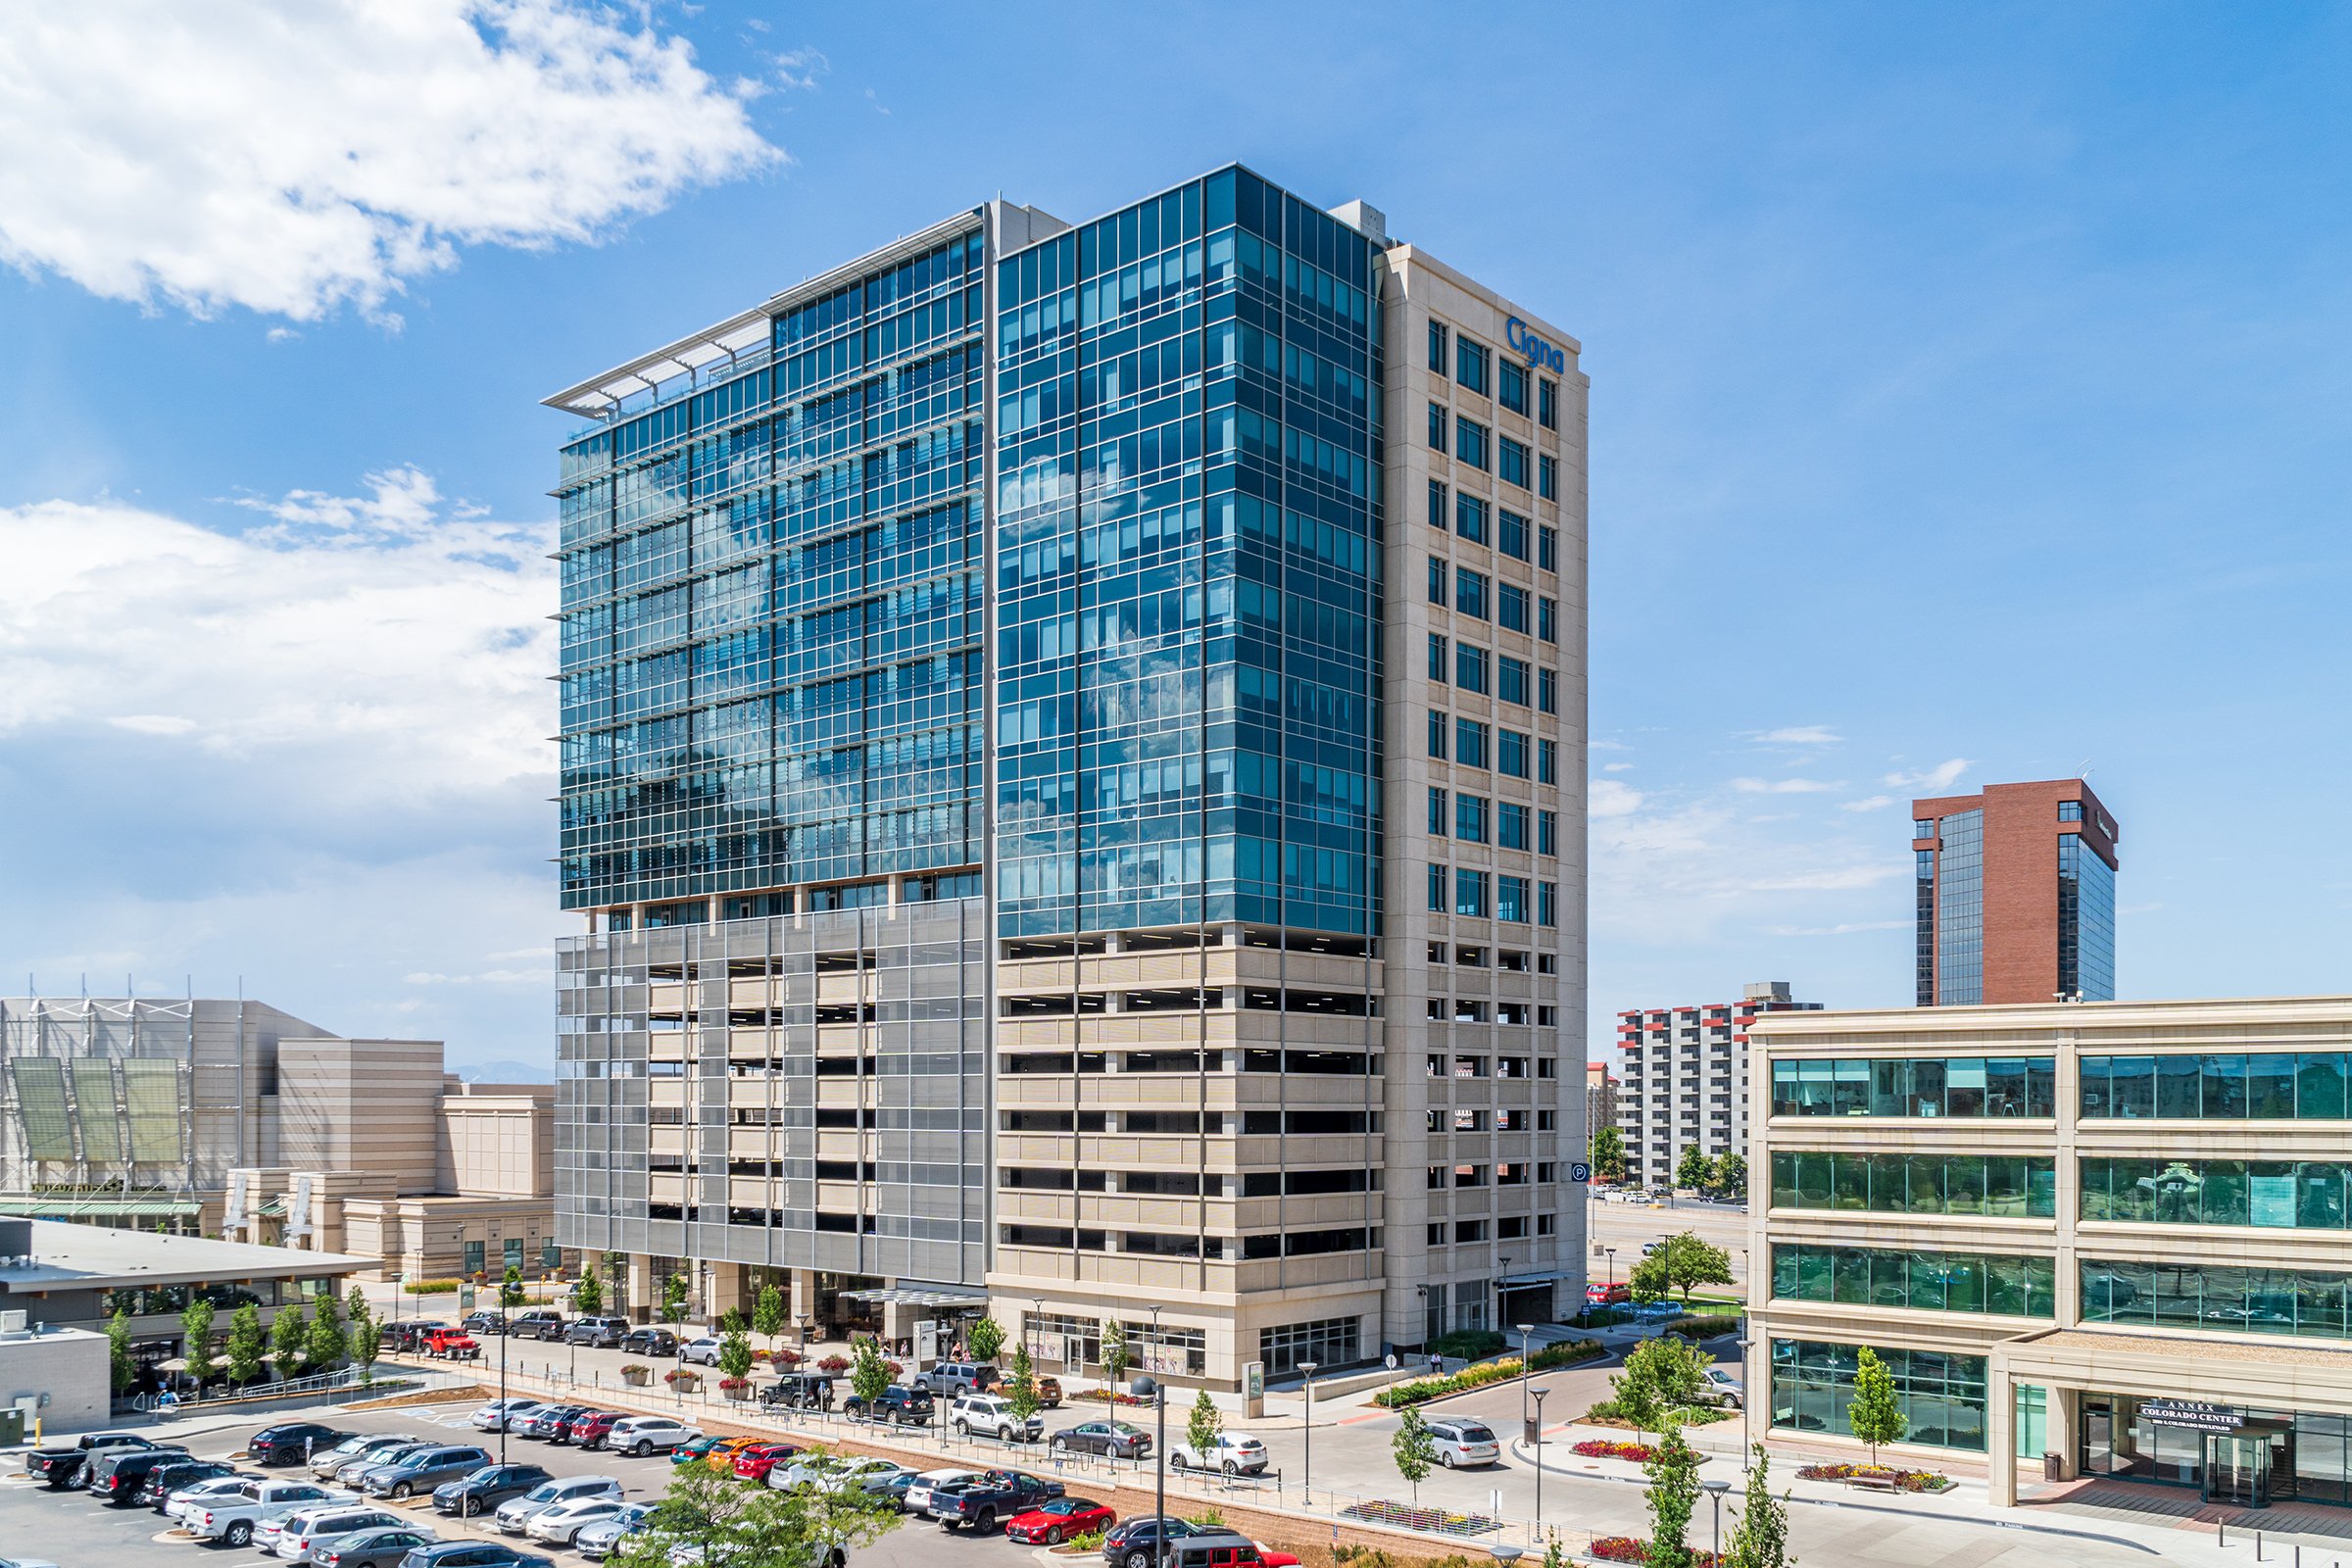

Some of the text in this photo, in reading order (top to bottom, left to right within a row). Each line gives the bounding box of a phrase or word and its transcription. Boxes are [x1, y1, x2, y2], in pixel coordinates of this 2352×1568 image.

[1506, 316, 1564, 374] Cigna
[913, 1325, 920, 1338] 3
[2168, 1401, 2214, 1411] ANNEX
[2142, 1407, 2240, 1424] COLORADO CENTER
